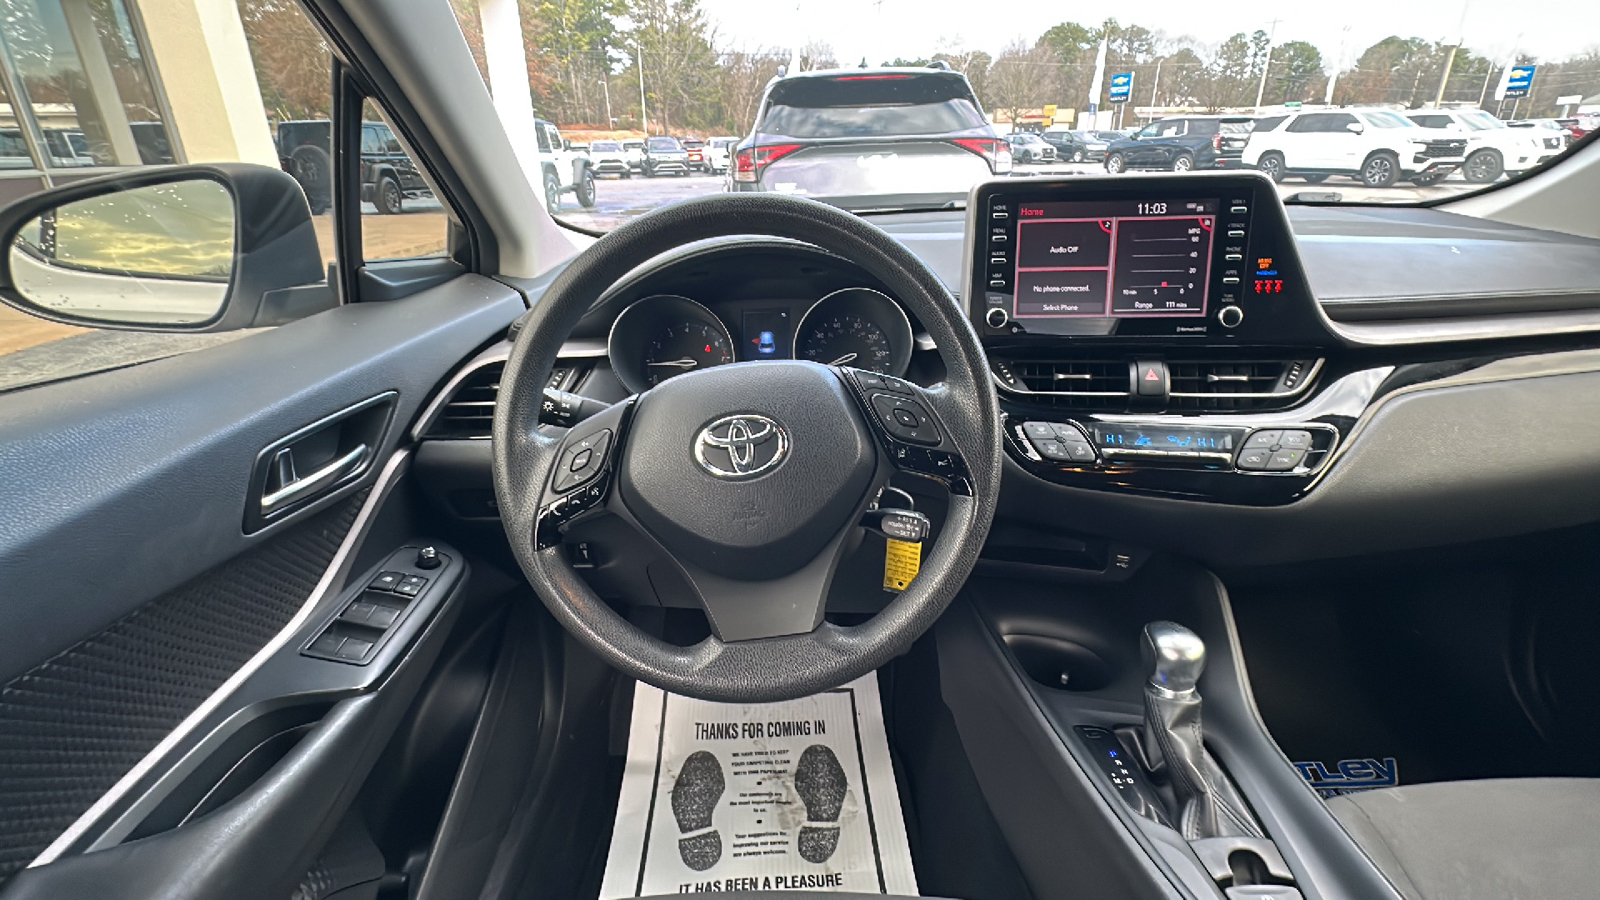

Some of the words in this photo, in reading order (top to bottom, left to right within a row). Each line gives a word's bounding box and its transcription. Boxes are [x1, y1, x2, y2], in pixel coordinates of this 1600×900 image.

[1021, 208, 1044, 216] Home
[1137, 203, 1167, 214] 11:03
[1106, 434, 1122, 443] HI
[1197, 438, 1214, 447] HI
[695, 722, 739, 740] THANKS
[742, 722, 764, 739] FOR
[767, 721, 811, 738] COMING
[814, 720, 826, 735] IN
[679, 884, 691, 894] IT
[695, 880, 721, 893] HAS
[725, 877, 758, 891] BEEN
[762, 876, 772, 890] A
[775, 872, 843, 889] PLEASURE
